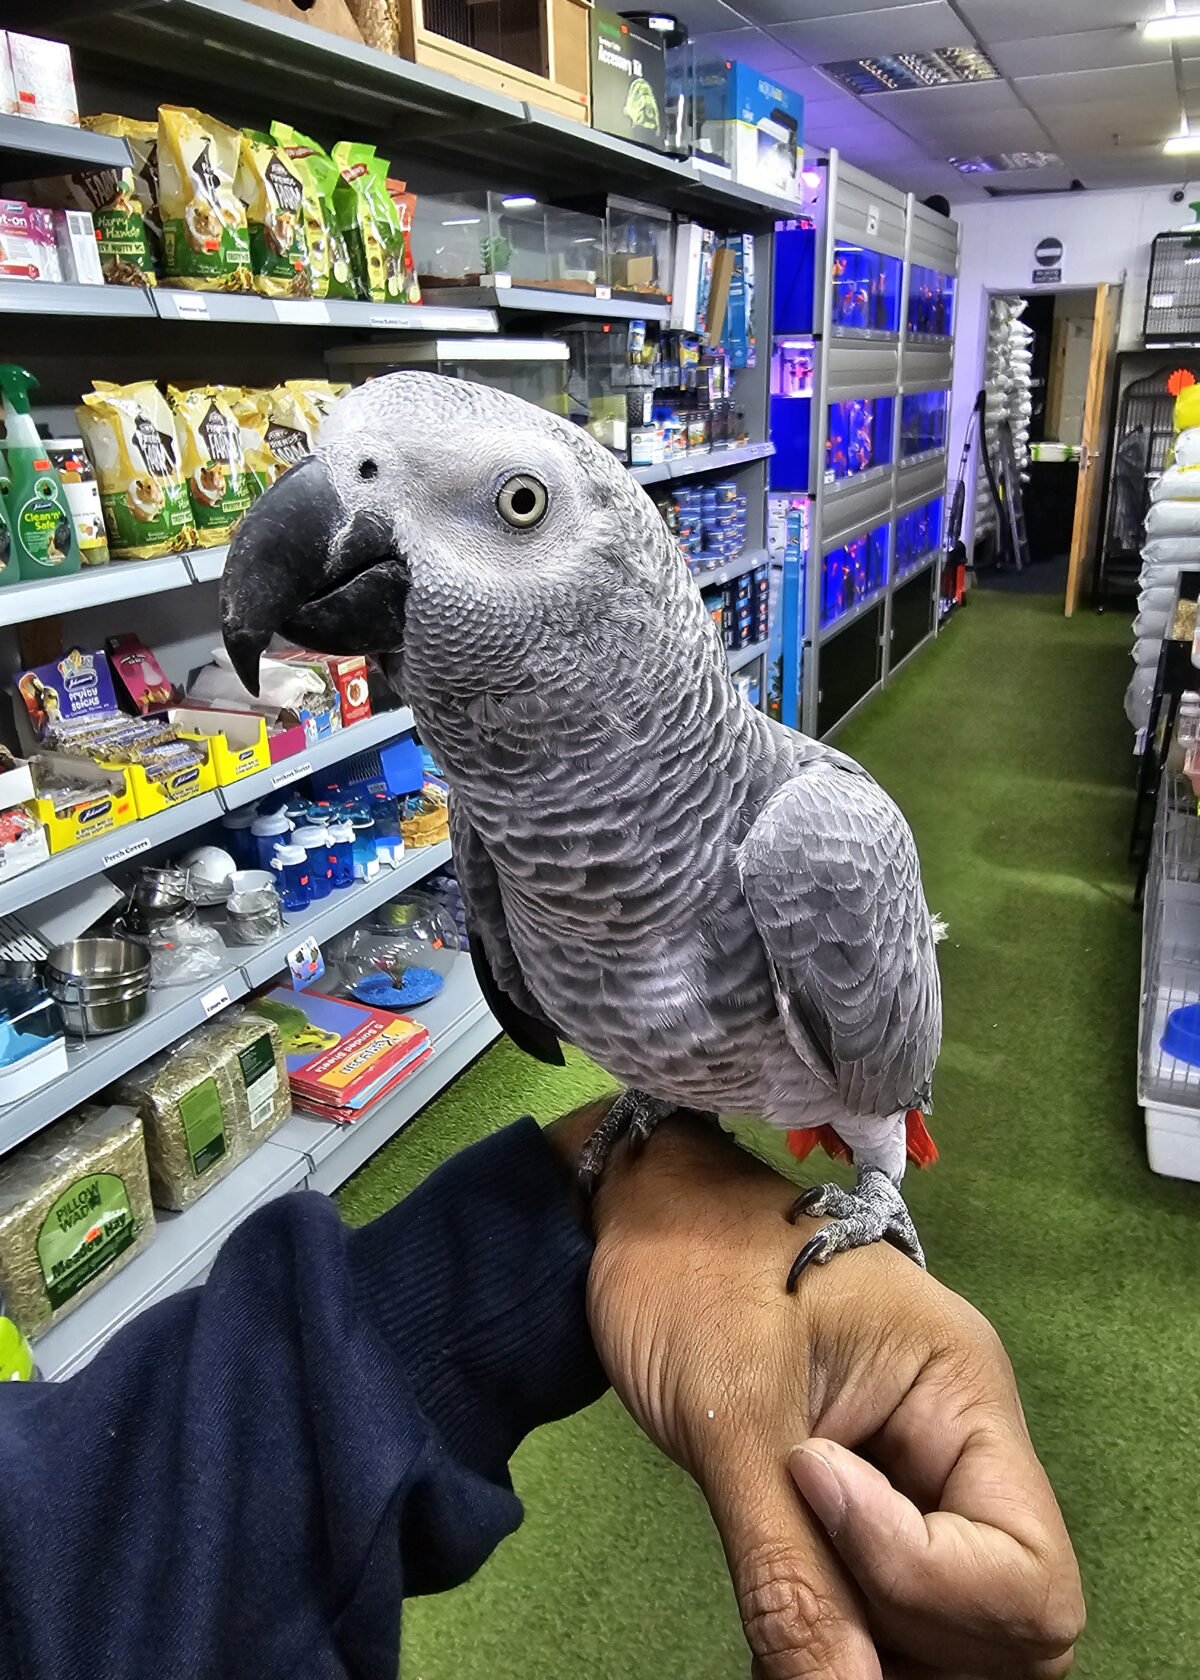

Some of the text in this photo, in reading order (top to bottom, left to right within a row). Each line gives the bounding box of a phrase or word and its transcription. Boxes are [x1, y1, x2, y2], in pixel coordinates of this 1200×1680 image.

[0, 214, 28, 228] t-on
[24, 512, 51, 523] Clean
[34, 520, 56, 531] Safe
[104, 840, 148, 863] Perch Covers
[343, 1028, 378, 1053] Sanded
[313, 1050, 348, 1074] Sheets
[55, 1180, 101, 1223] PILLOW
